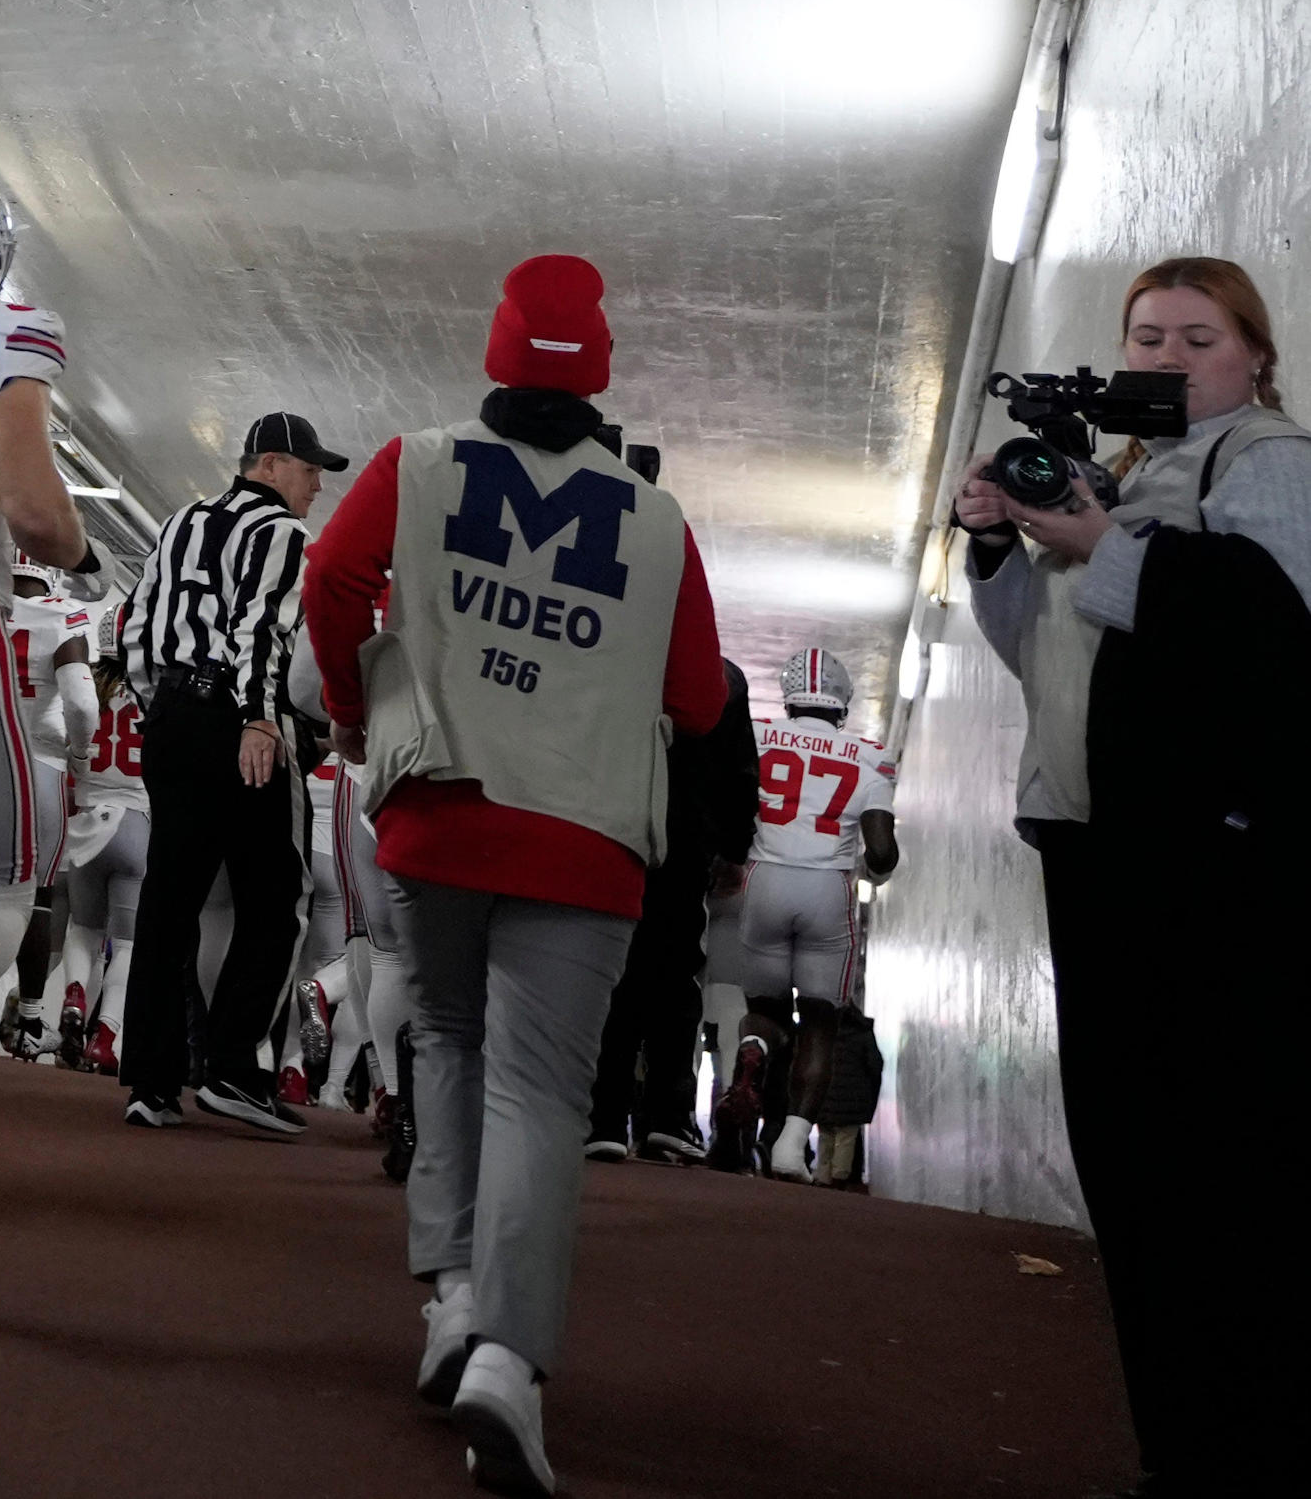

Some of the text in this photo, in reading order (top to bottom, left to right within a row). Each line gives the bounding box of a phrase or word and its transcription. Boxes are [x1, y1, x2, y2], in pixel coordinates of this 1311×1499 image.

[444, 439, 636, 601] M
[451, 568, 603, 649] VIDEO
[480, 646, 542, 695] 156
[761, 729, 860, 764] JACKSON JR.
[759, 748, 860, 837] 97
